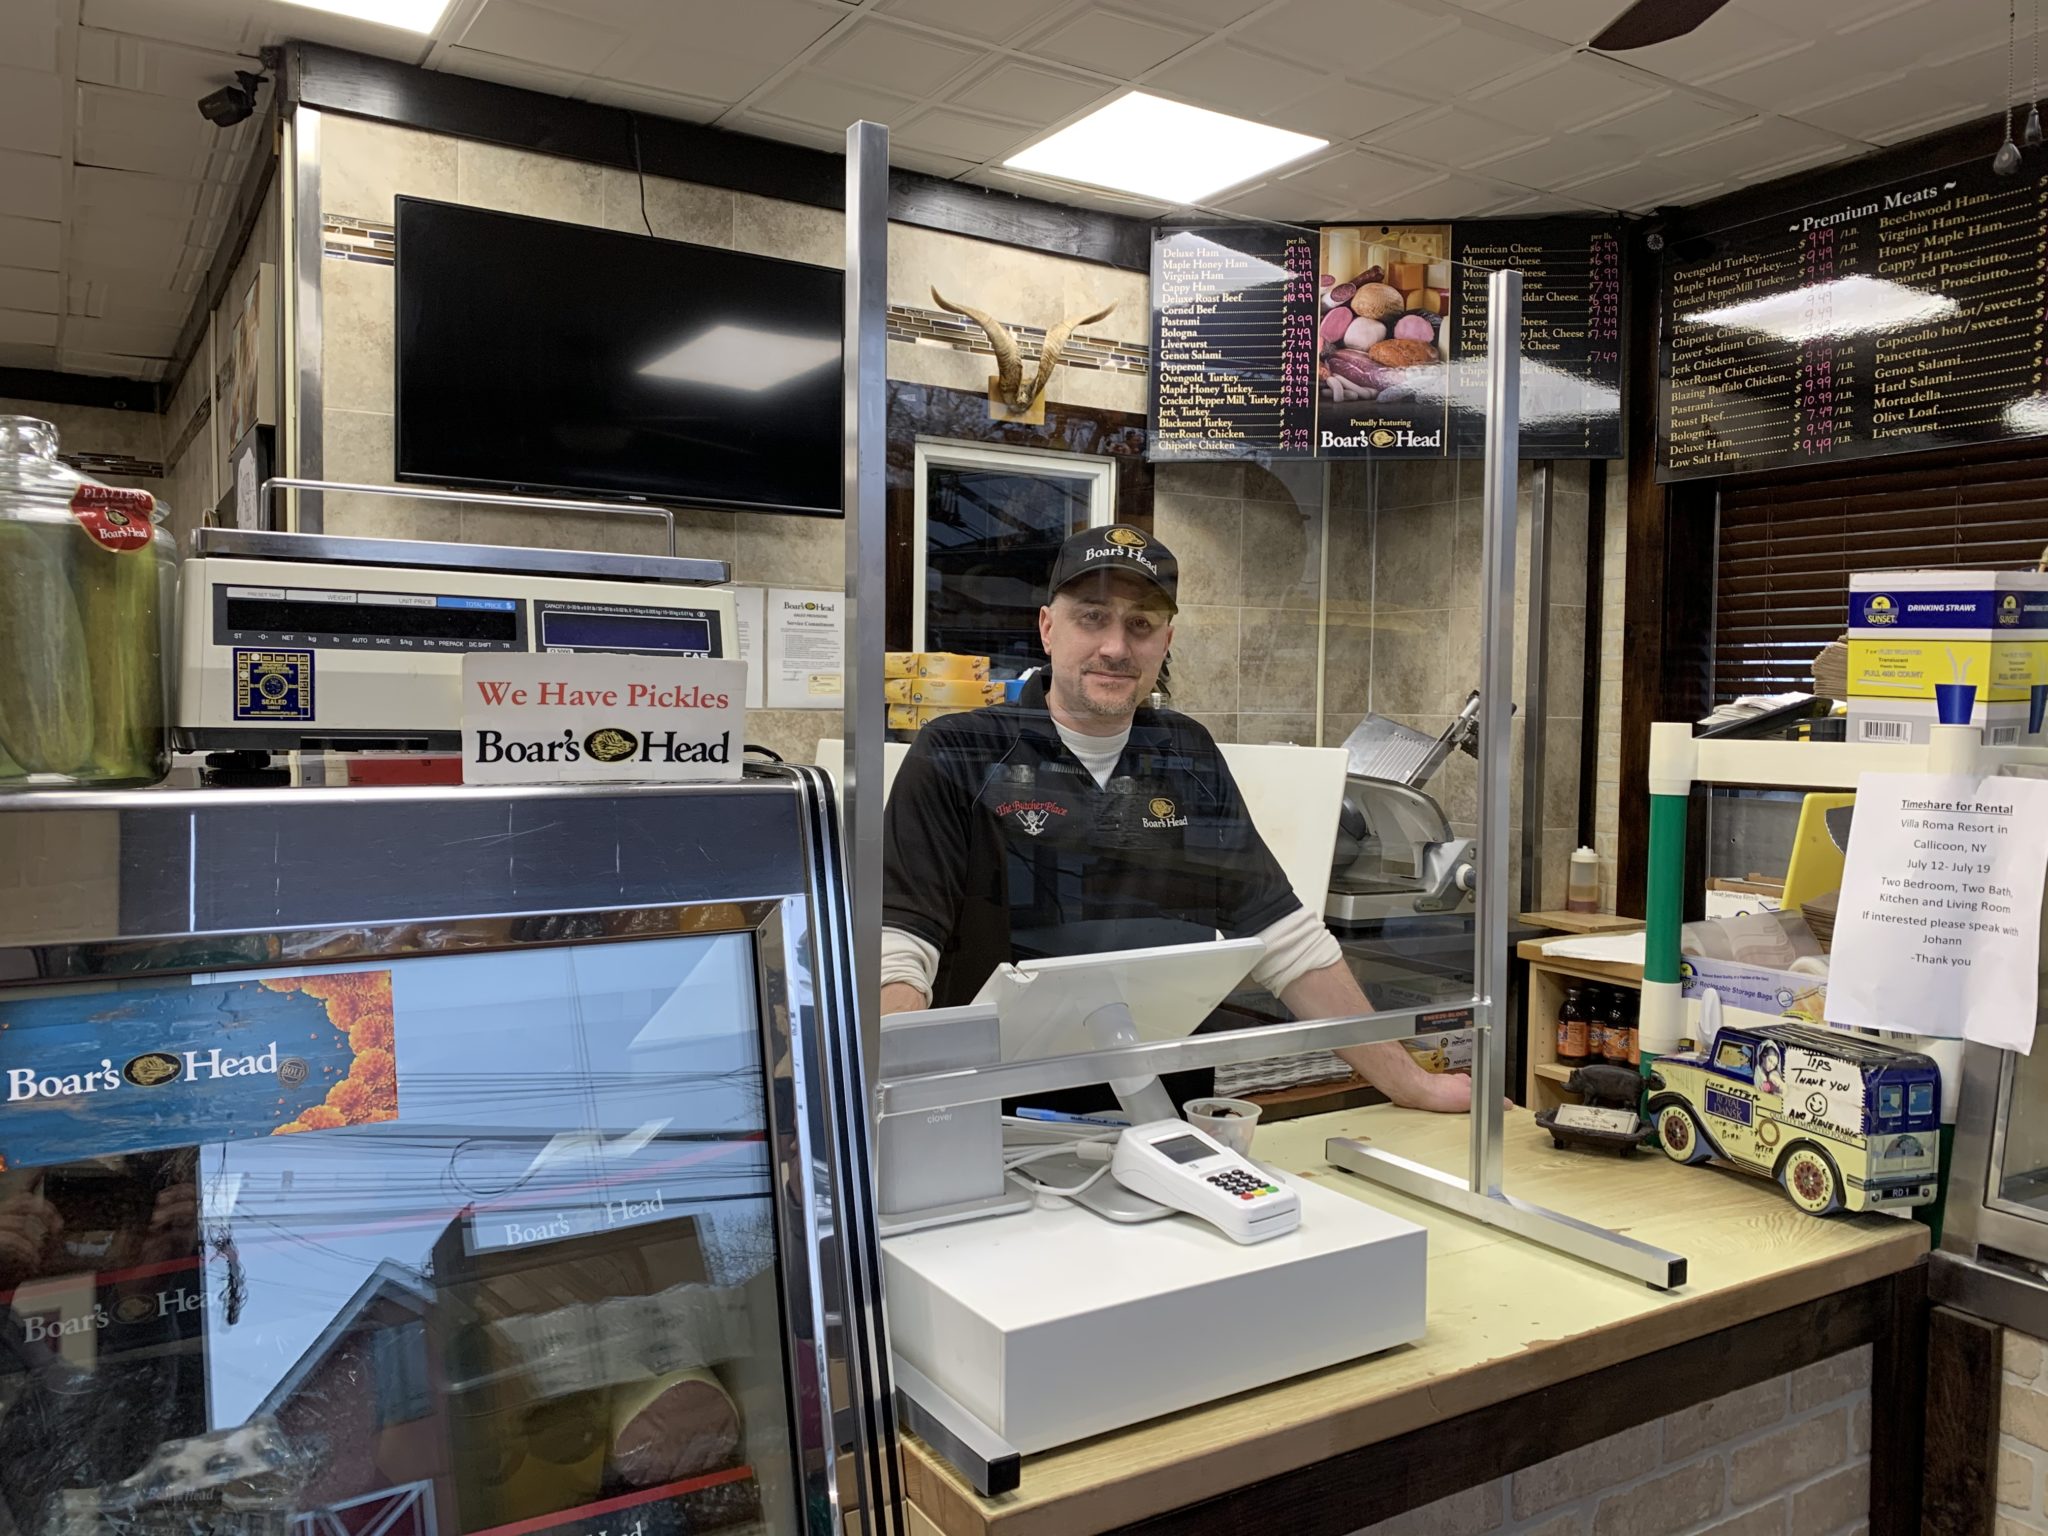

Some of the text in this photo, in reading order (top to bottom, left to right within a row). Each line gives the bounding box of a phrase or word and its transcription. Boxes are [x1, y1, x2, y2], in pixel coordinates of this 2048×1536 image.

[1802, 187, 1937, 232] Premium Meats
[1879, 214, 1966, 243] Virginia Ham
[1879, 222, 2003, 258] Honey Maple Ham
[1164, 249, 1194, 257] Deluxe
[1463, 244, 1542, 253] American Cheese
[1163, 260, 1191, 272] Maple
[1194, 260, 1223, 270] Honey
[1225, 260, 1247, 268] Ham
[1463, 256, 1540, 265] Muenster Cheese
[1878, 250, 1954, 274] Cappy Ham
[1164, 272, 1223, 282] Virginia Ham
[1163, 283, 1189, 294] Cappy
[1197, 283, 1215, 291] Ham
[1162, 293, 1243, 303] Deluxe Roast Beef
[1546, 292, 1579, 301] Cheese
[1162, 305, 1217, 315] Corned Beef
[1462, 305, 1485, 314] Swiss
[1162, 316, 1200, 326] Pastrami
[1162, 329, 1197, 339] Bologna
[1161, 340, 1208, 349] Liverwurst
[1528, 341, 1560, 350] Cheese
[1673, 333, 1713, 349] Chipotle
[1161, 351, 1221, 360] Genoa Salami
[1673, 338, 1744, 361] Lower Sodium
[1876, 348, 1928, 364] Pancetta
[1160, 362, 1205, 373] Pepperoni
[1875, 355, 1961, 379] Genoa Salami
[1160, 373, 1239, 385] Ovengold Turkey
[1874, 372, 1953, 394] Hard Salami
[1160, 384, 1253, 395] Maple Honey Turkey
[1160, 396, 1194, 405] Cracked
[1195, 396, 1225, 408] Pepper
[1249, 395, 1279, 406] Turkey
[1874, 390, 1941, 409] Mortadella
[1158, 407, 1210, 418] Jerk Turkey
[1671, 400, 1714, 415] Pastrami
[1873, 405, 1939, 424] Olive Loaf
[1159, 418, 1232, 429] Blackened Turkey
[1350, 419, 1411, 428] Proudly Featuring
[1159, 429, 1245, 438] EverRoast Chicken
[1670, 428, 1710, 442] Bologna
[1872, 422, 1938, 439] Liverwurst
[1321, 430, 1440, 447] Boar's Head
[1159, 440, 1235, 453] Chipotle Chicken
[1670, 438, 1733, 455] Deluxe Ham
[1670, 450, 1740, 468] Low Salt Ham
[99, 527, 147, 539] Boar's Head
[1084, 545, 1157, 575] Boar's Head
[1908, 604, 1976, 612] DRINKING STRAWS
[1868, 614, 1896, 624] SUNSET
[476, 681, 729, 709] We Have Pickles
[476, 729, 730, 764] Boar's Head
[996, 800, 1068, 816] The Butcher Place
[1901, 799, 2013, 814] Timeshare for Rental
[1142, 815, 1188, 828] Boar's Head
[1901, 819, 2007, 834] Villa Roma Resort in
[1914, 840, 1987, 853] Callicoon, NY
[1907, 859, 1990, 874] July 12- July 19
[1882, 877, 2013, 898] Two Bedroom, Two Bath,
[1880, 894, 2010, 914] Kitchen and Living Room
[1862, 911, 2019, 937] If interested please speak with
[1923, 935, 1962, 946] Johann
[1911, 953, 1971, 967] -Thank you
[1732, 987, 1756, 998] Storage
[1757, 992, 1772, 1001] Bags
[7, 1041, 278, 1100] Boar's Head
[927, 1114, 952, 1124] clover
[1892, 1188, 1904, 1197] RD
[503, 1189, 665, 1247] Boar's Head
